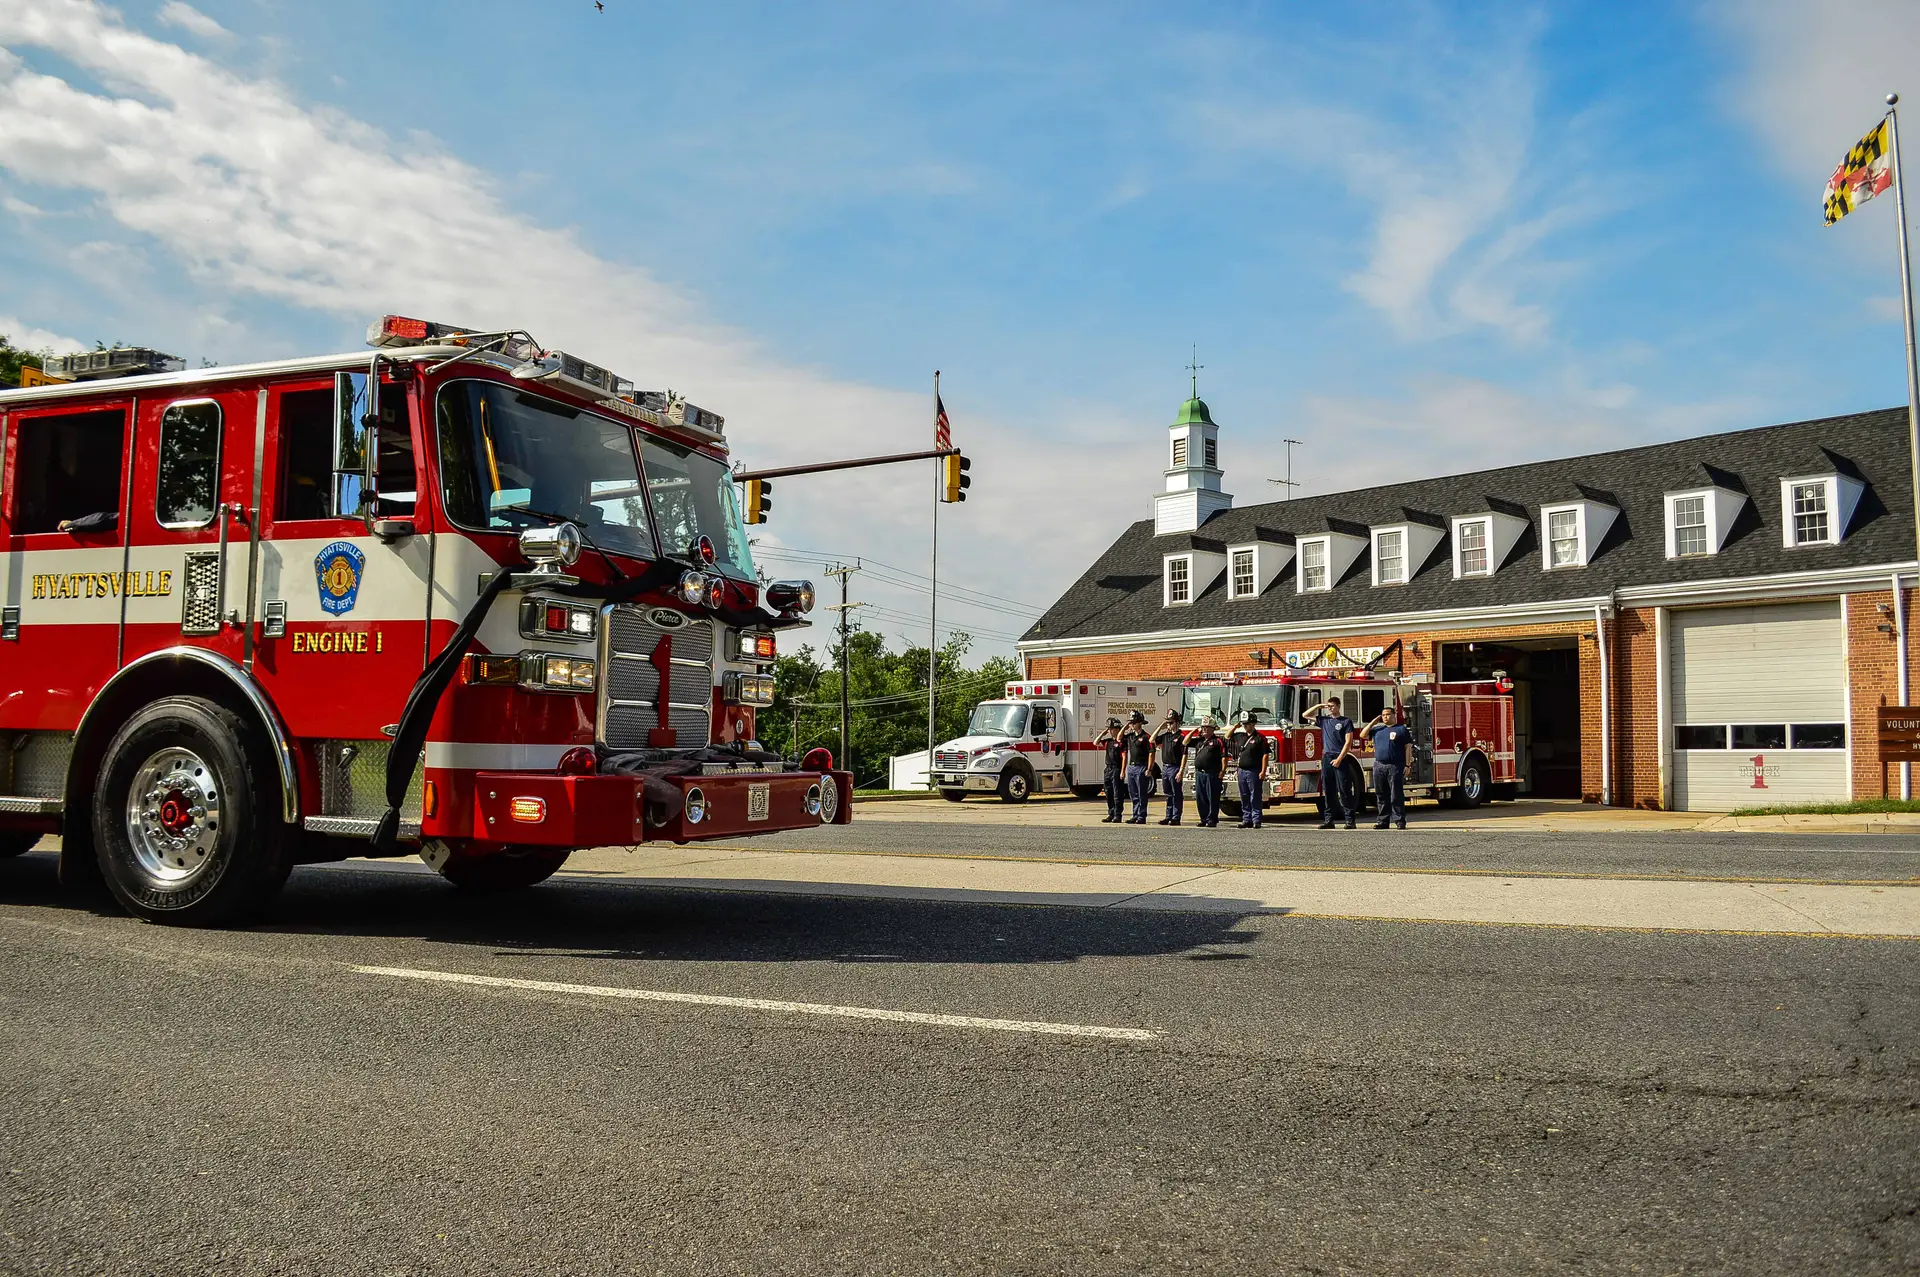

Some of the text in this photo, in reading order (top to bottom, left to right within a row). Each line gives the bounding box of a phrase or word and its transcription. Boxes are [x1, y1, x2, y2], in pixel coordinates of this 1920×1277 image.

[319, 542, 361, 561] HYATTSVILLE
[32, 570, 172, 599] HYATTSVILLE
[337, 571, 343, 586] 1
[322, 597, 354, 609] FIRE DEPT.
[654, 610, 680, 624] Pierce
[292, 632, 368, 653] ENGINE
[648, 634, 677, 748] 1
[1886, 720, 1920, 729] VOLUNT
[1739, 765, 1780, 776] TRUCK
[1749, 754, 1768, 788] 1
